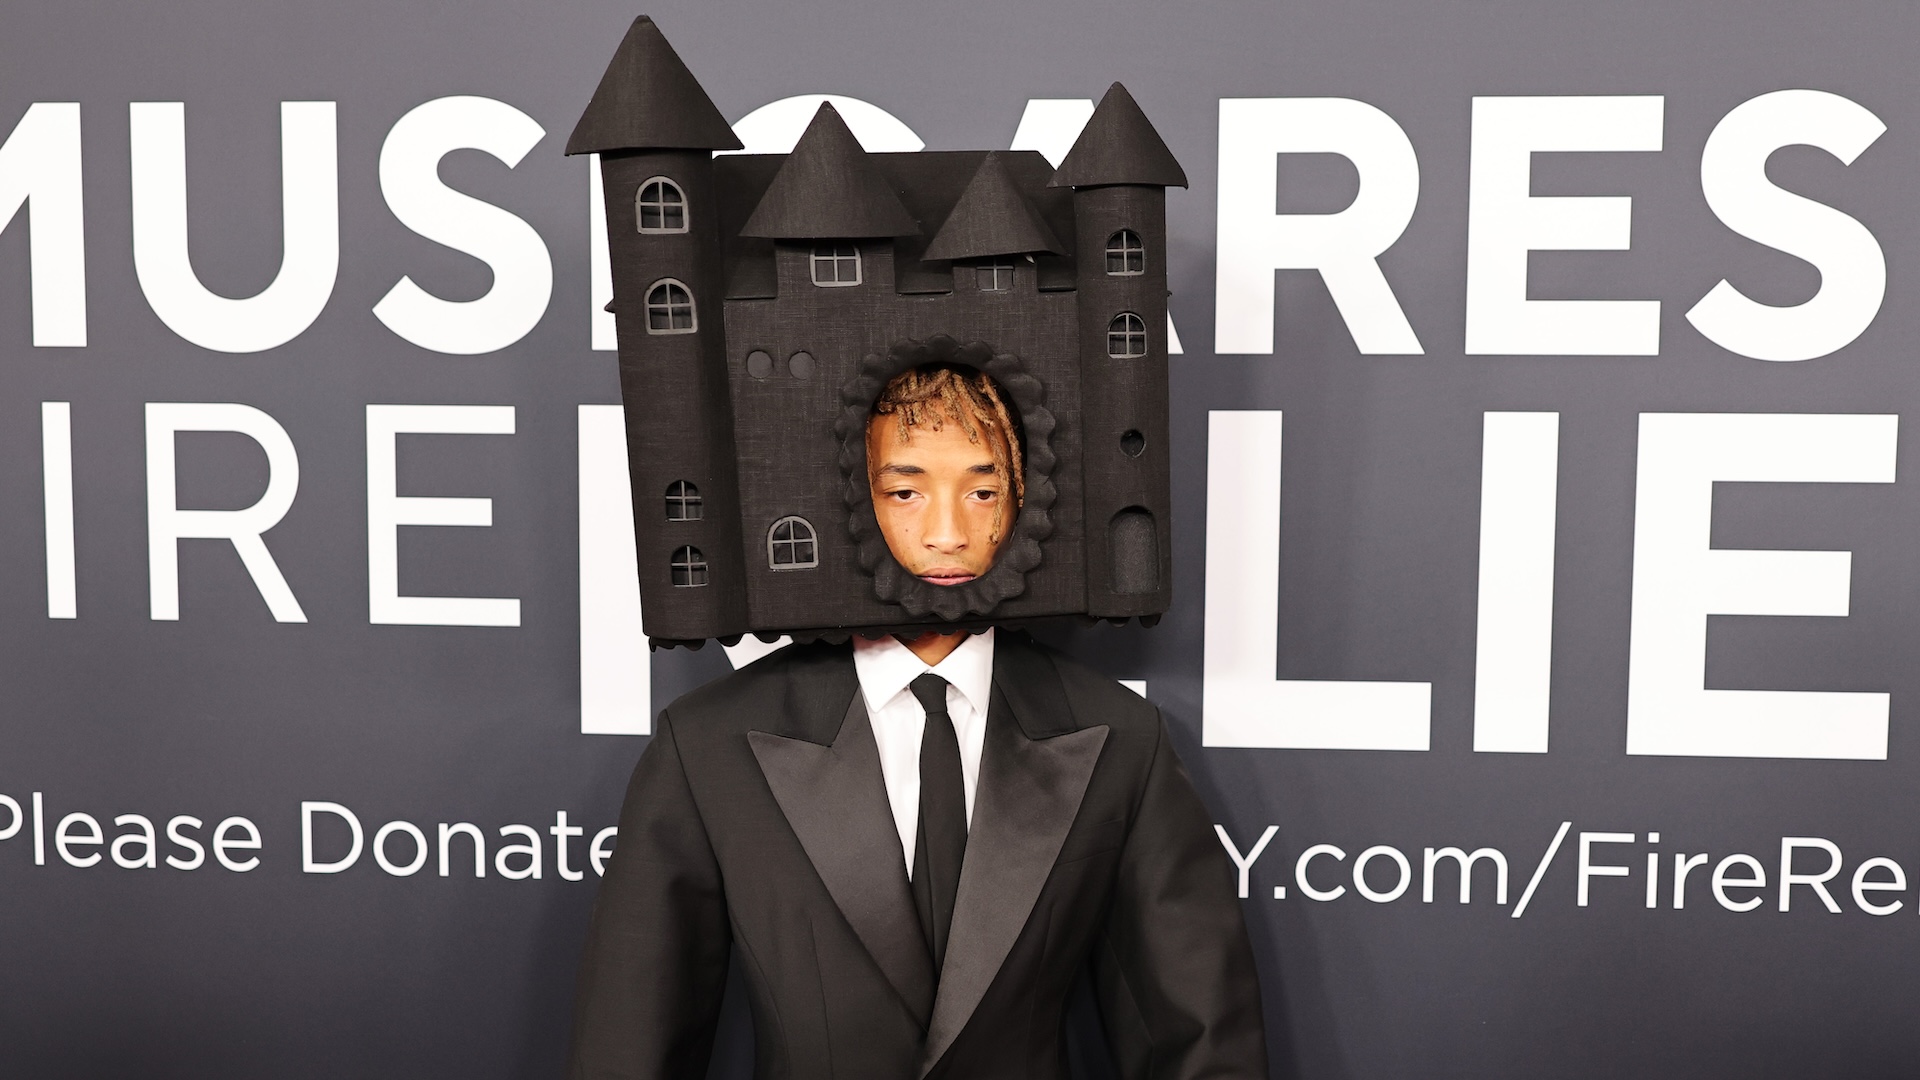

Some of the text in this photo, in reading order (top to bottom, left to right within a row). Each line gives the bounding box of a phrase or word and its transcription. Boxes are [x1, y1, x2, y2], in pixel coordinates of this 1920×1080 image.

[0, 90, 1888, 361] USRES
[578, 404, 1898, 760] LIE
[301, 801, 619, 882] Donate
[1213, 821, 1920, 918] Y.com/FireRe
